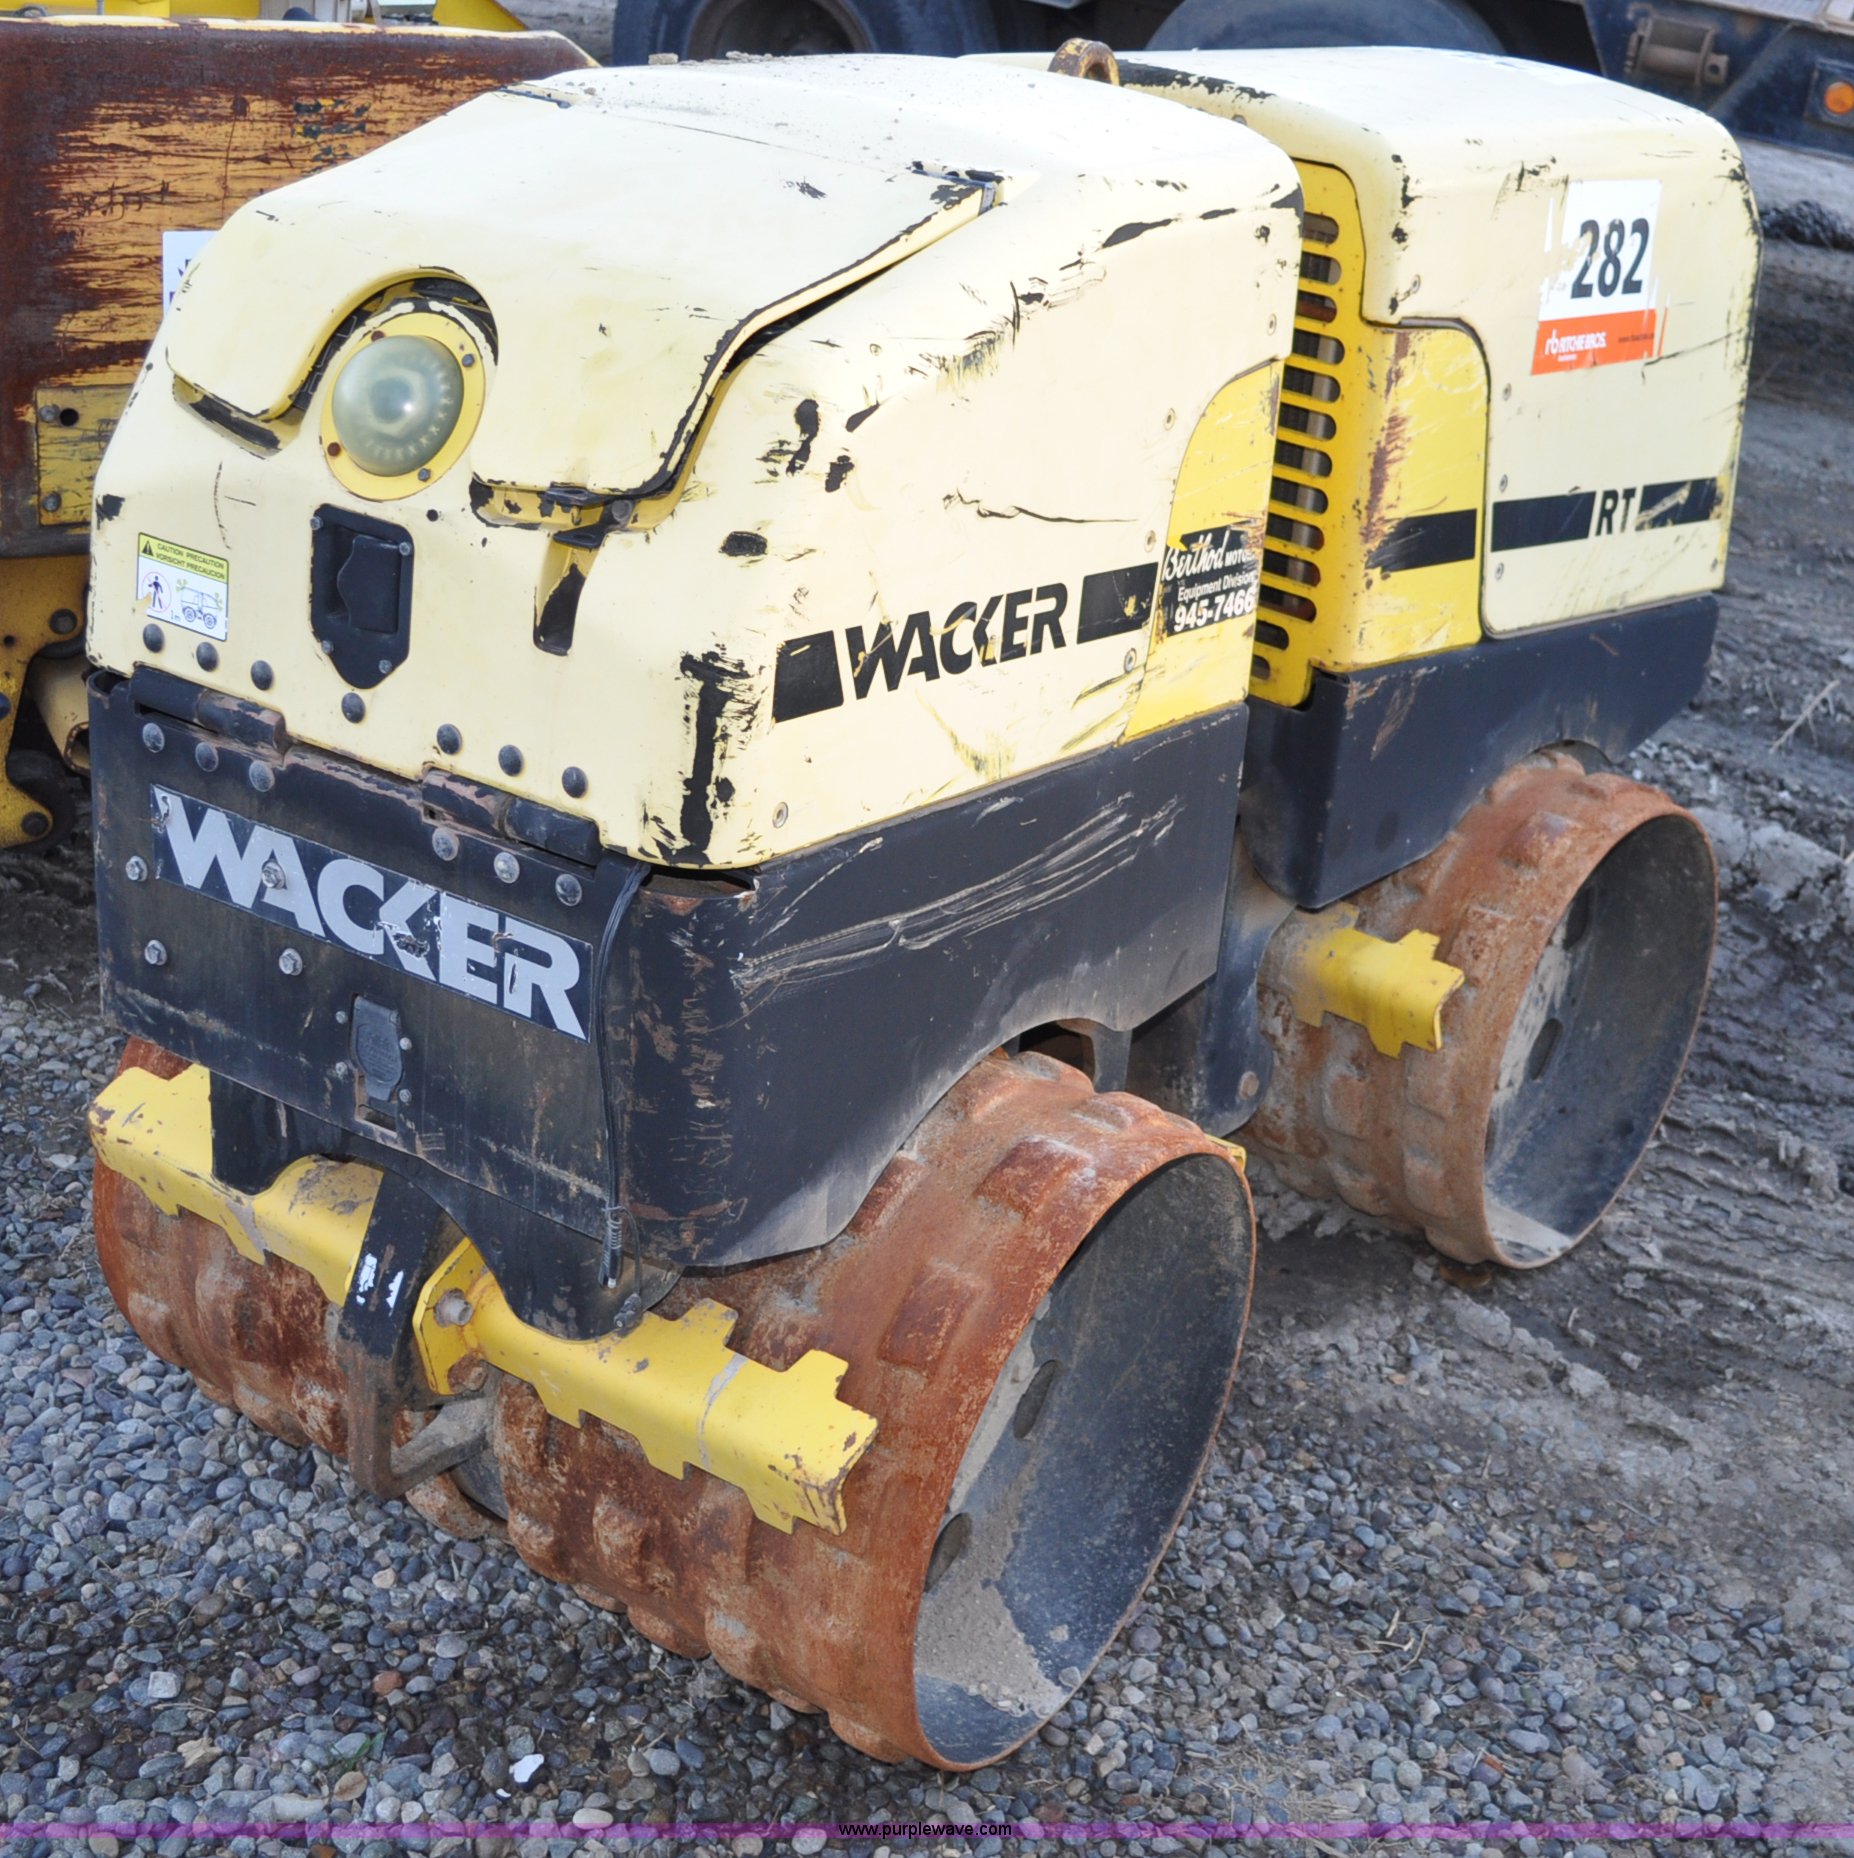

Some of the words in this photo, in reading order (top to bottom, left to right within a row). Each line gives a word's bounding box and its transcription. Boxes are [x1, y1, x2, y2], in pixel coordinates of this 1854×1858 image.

[1570, 217, 1650, 299] 282
[1595, 487, 1637, 537] RT
[156, 552, 185, 567] VORSICHT
[157, 543, 184, 556] CAUTION
[186, 552, 225, 569] PRECAUTION
[1173, 587, 1258, 632] 945-7466
[1177, 578, 1222, 603] Equipment
[1222, 570, 1257, 590] Division
[845, 583, 1069, 700] WACKER
[154, 788, 588, 1040] WACKER
